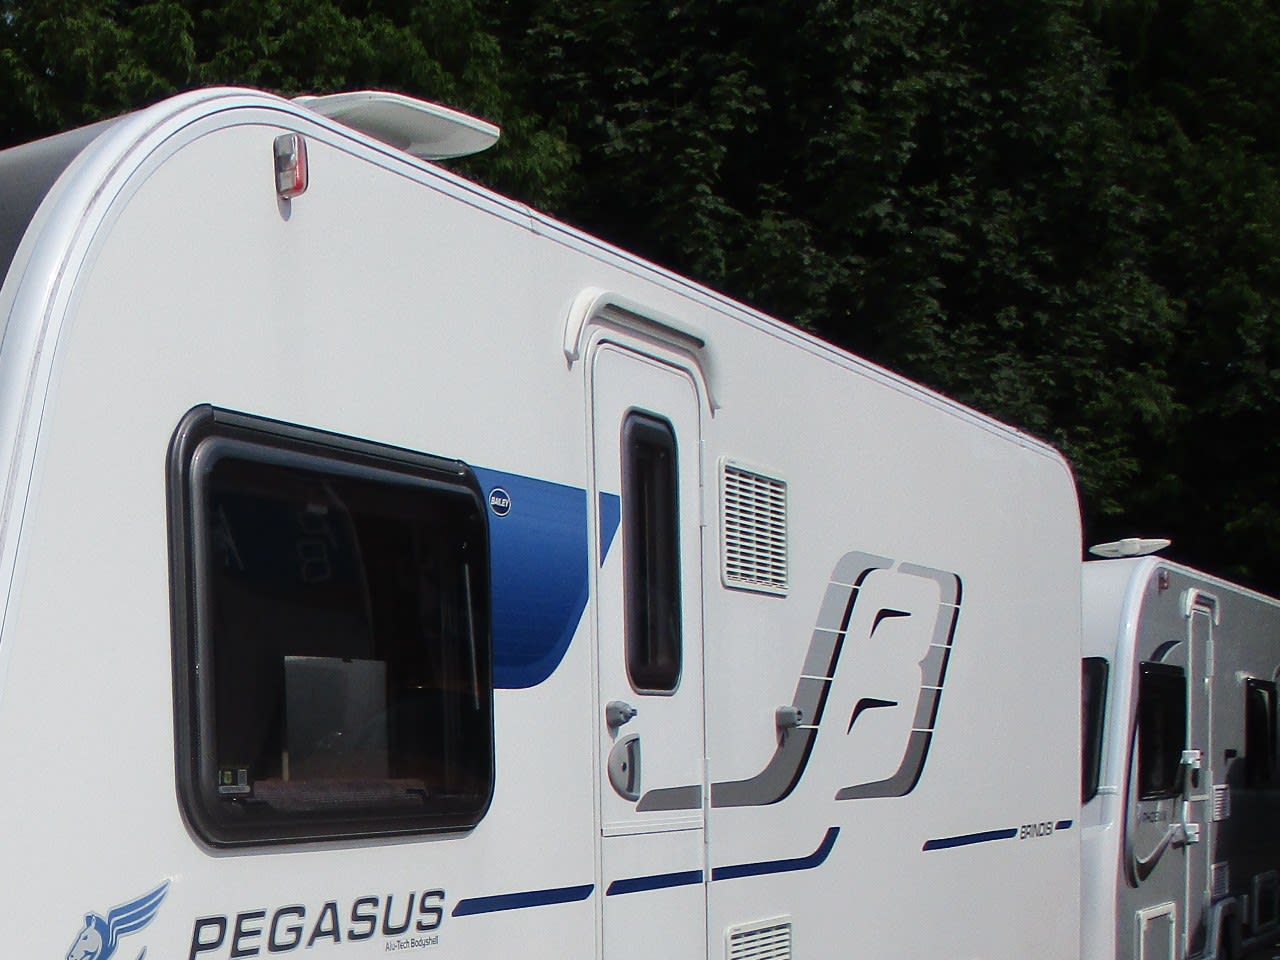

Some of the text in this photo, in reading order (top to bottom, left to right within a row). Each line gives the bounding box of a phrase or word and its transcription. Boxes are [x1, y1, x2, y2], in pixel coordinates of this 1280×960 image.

[490, 496, 509, 508] BAILEY
[385, 935, 439, 952] Alu-Tech Bodyshell
